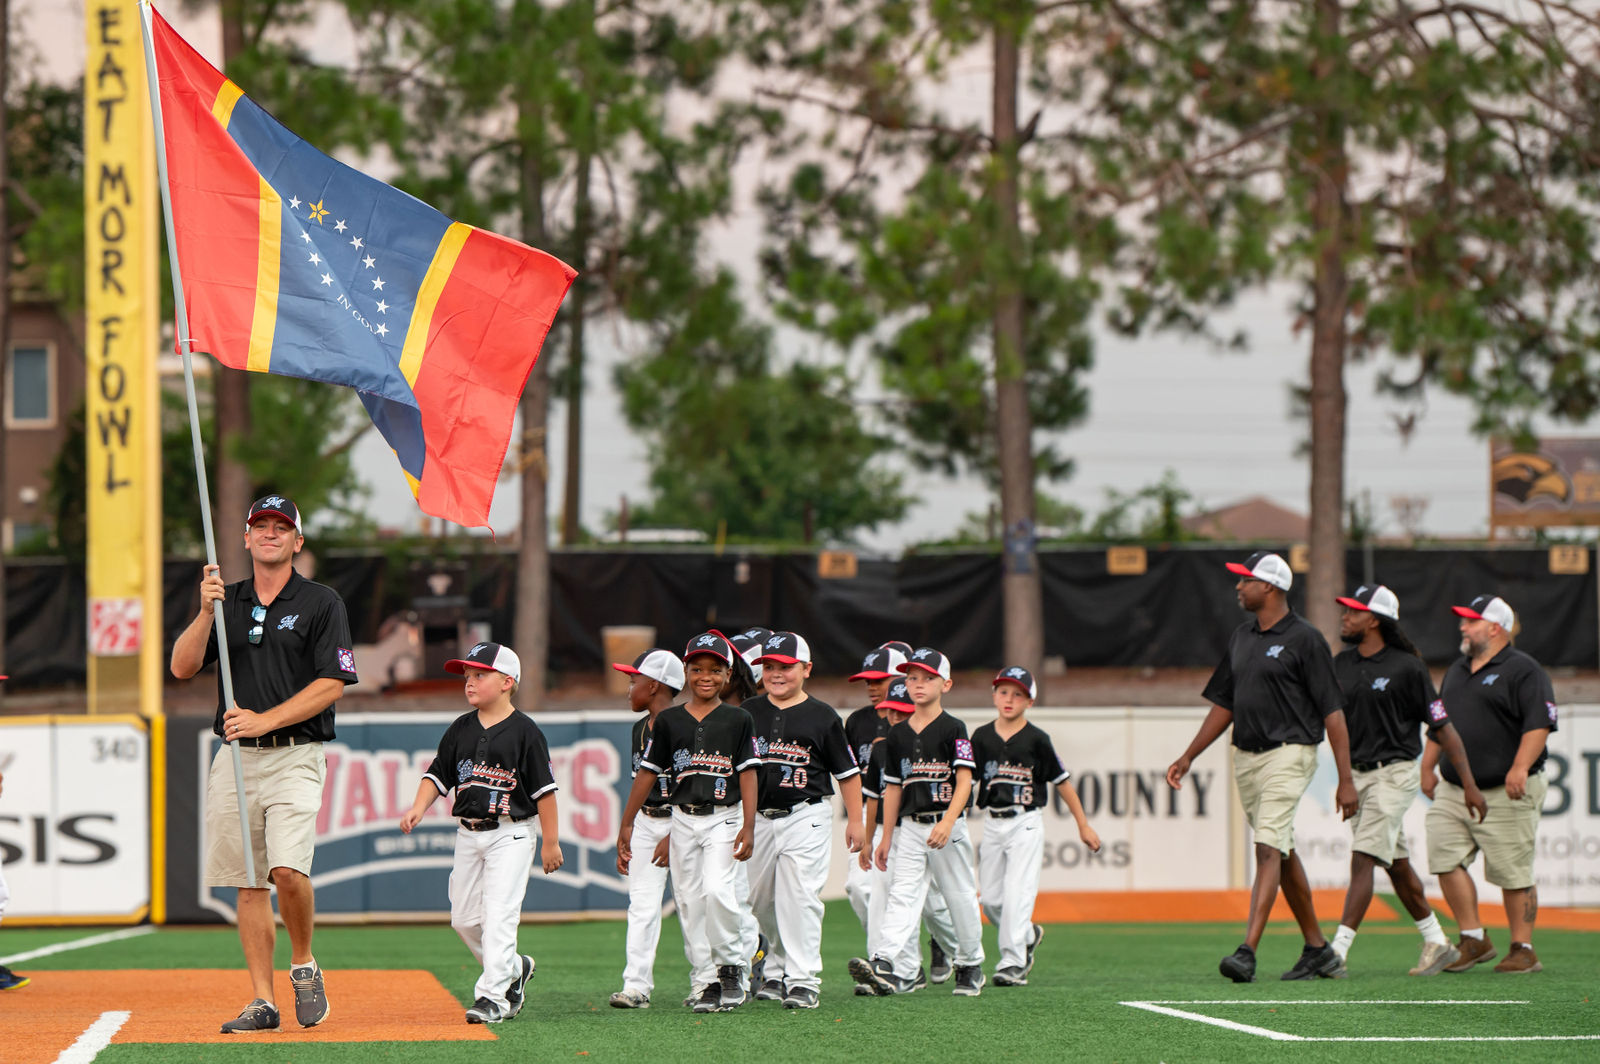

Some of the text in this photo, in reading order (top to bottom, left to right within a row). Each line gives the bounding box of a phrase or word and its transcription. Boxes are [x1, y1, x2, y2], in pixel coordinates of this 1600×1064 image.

[96, 8, 132, 493] EAT MOR FOWL
[337, 294, 352, 310] IN
[92, 735, 139, 763] 340
[714, 777, 727, 800] 8
[779, 765, 808, 789] 20
[488, 791, 511, 815] 14
[929, 782, 953, 803] 18
